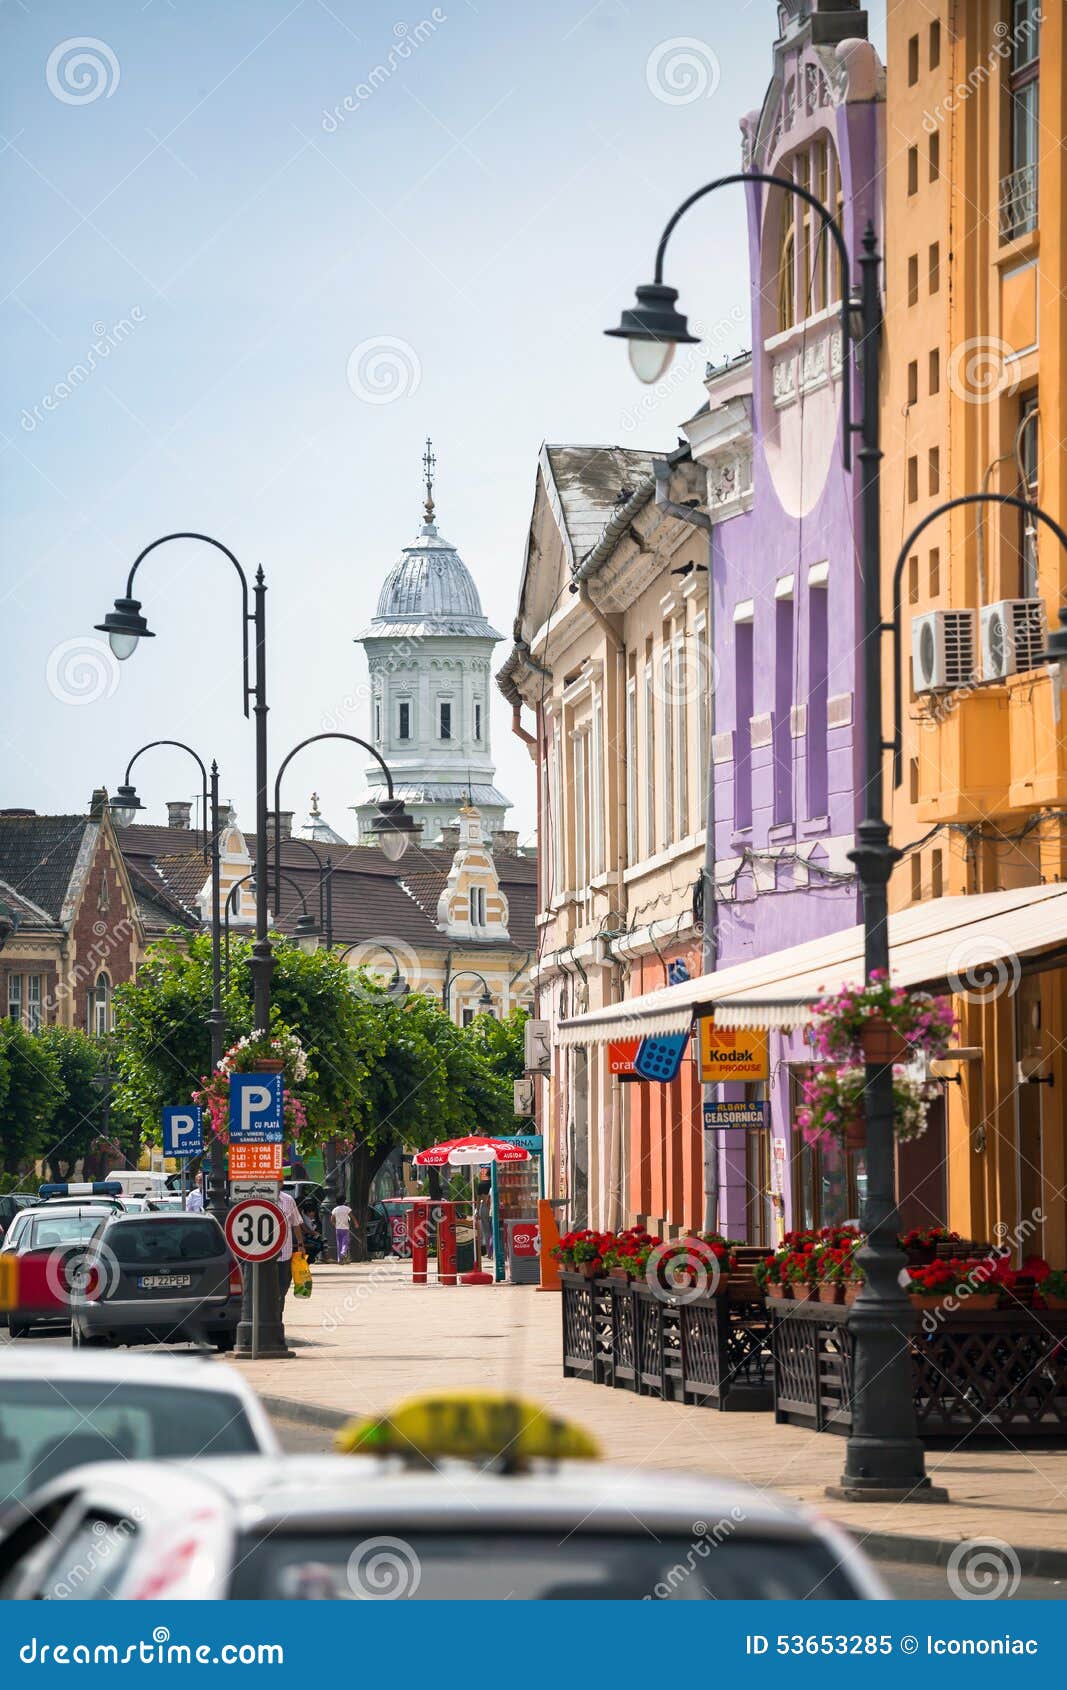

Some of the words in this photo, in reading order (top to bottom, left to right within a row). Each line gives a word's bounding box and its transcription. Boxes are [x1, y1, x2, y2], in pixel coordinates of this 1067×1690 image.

[709, 1050, 753, 1062] Kodak
[241, 1086, 271, 1130] P
[171, 1115, 194, 1148] P
[237, 1213, 274, 1246] 30
